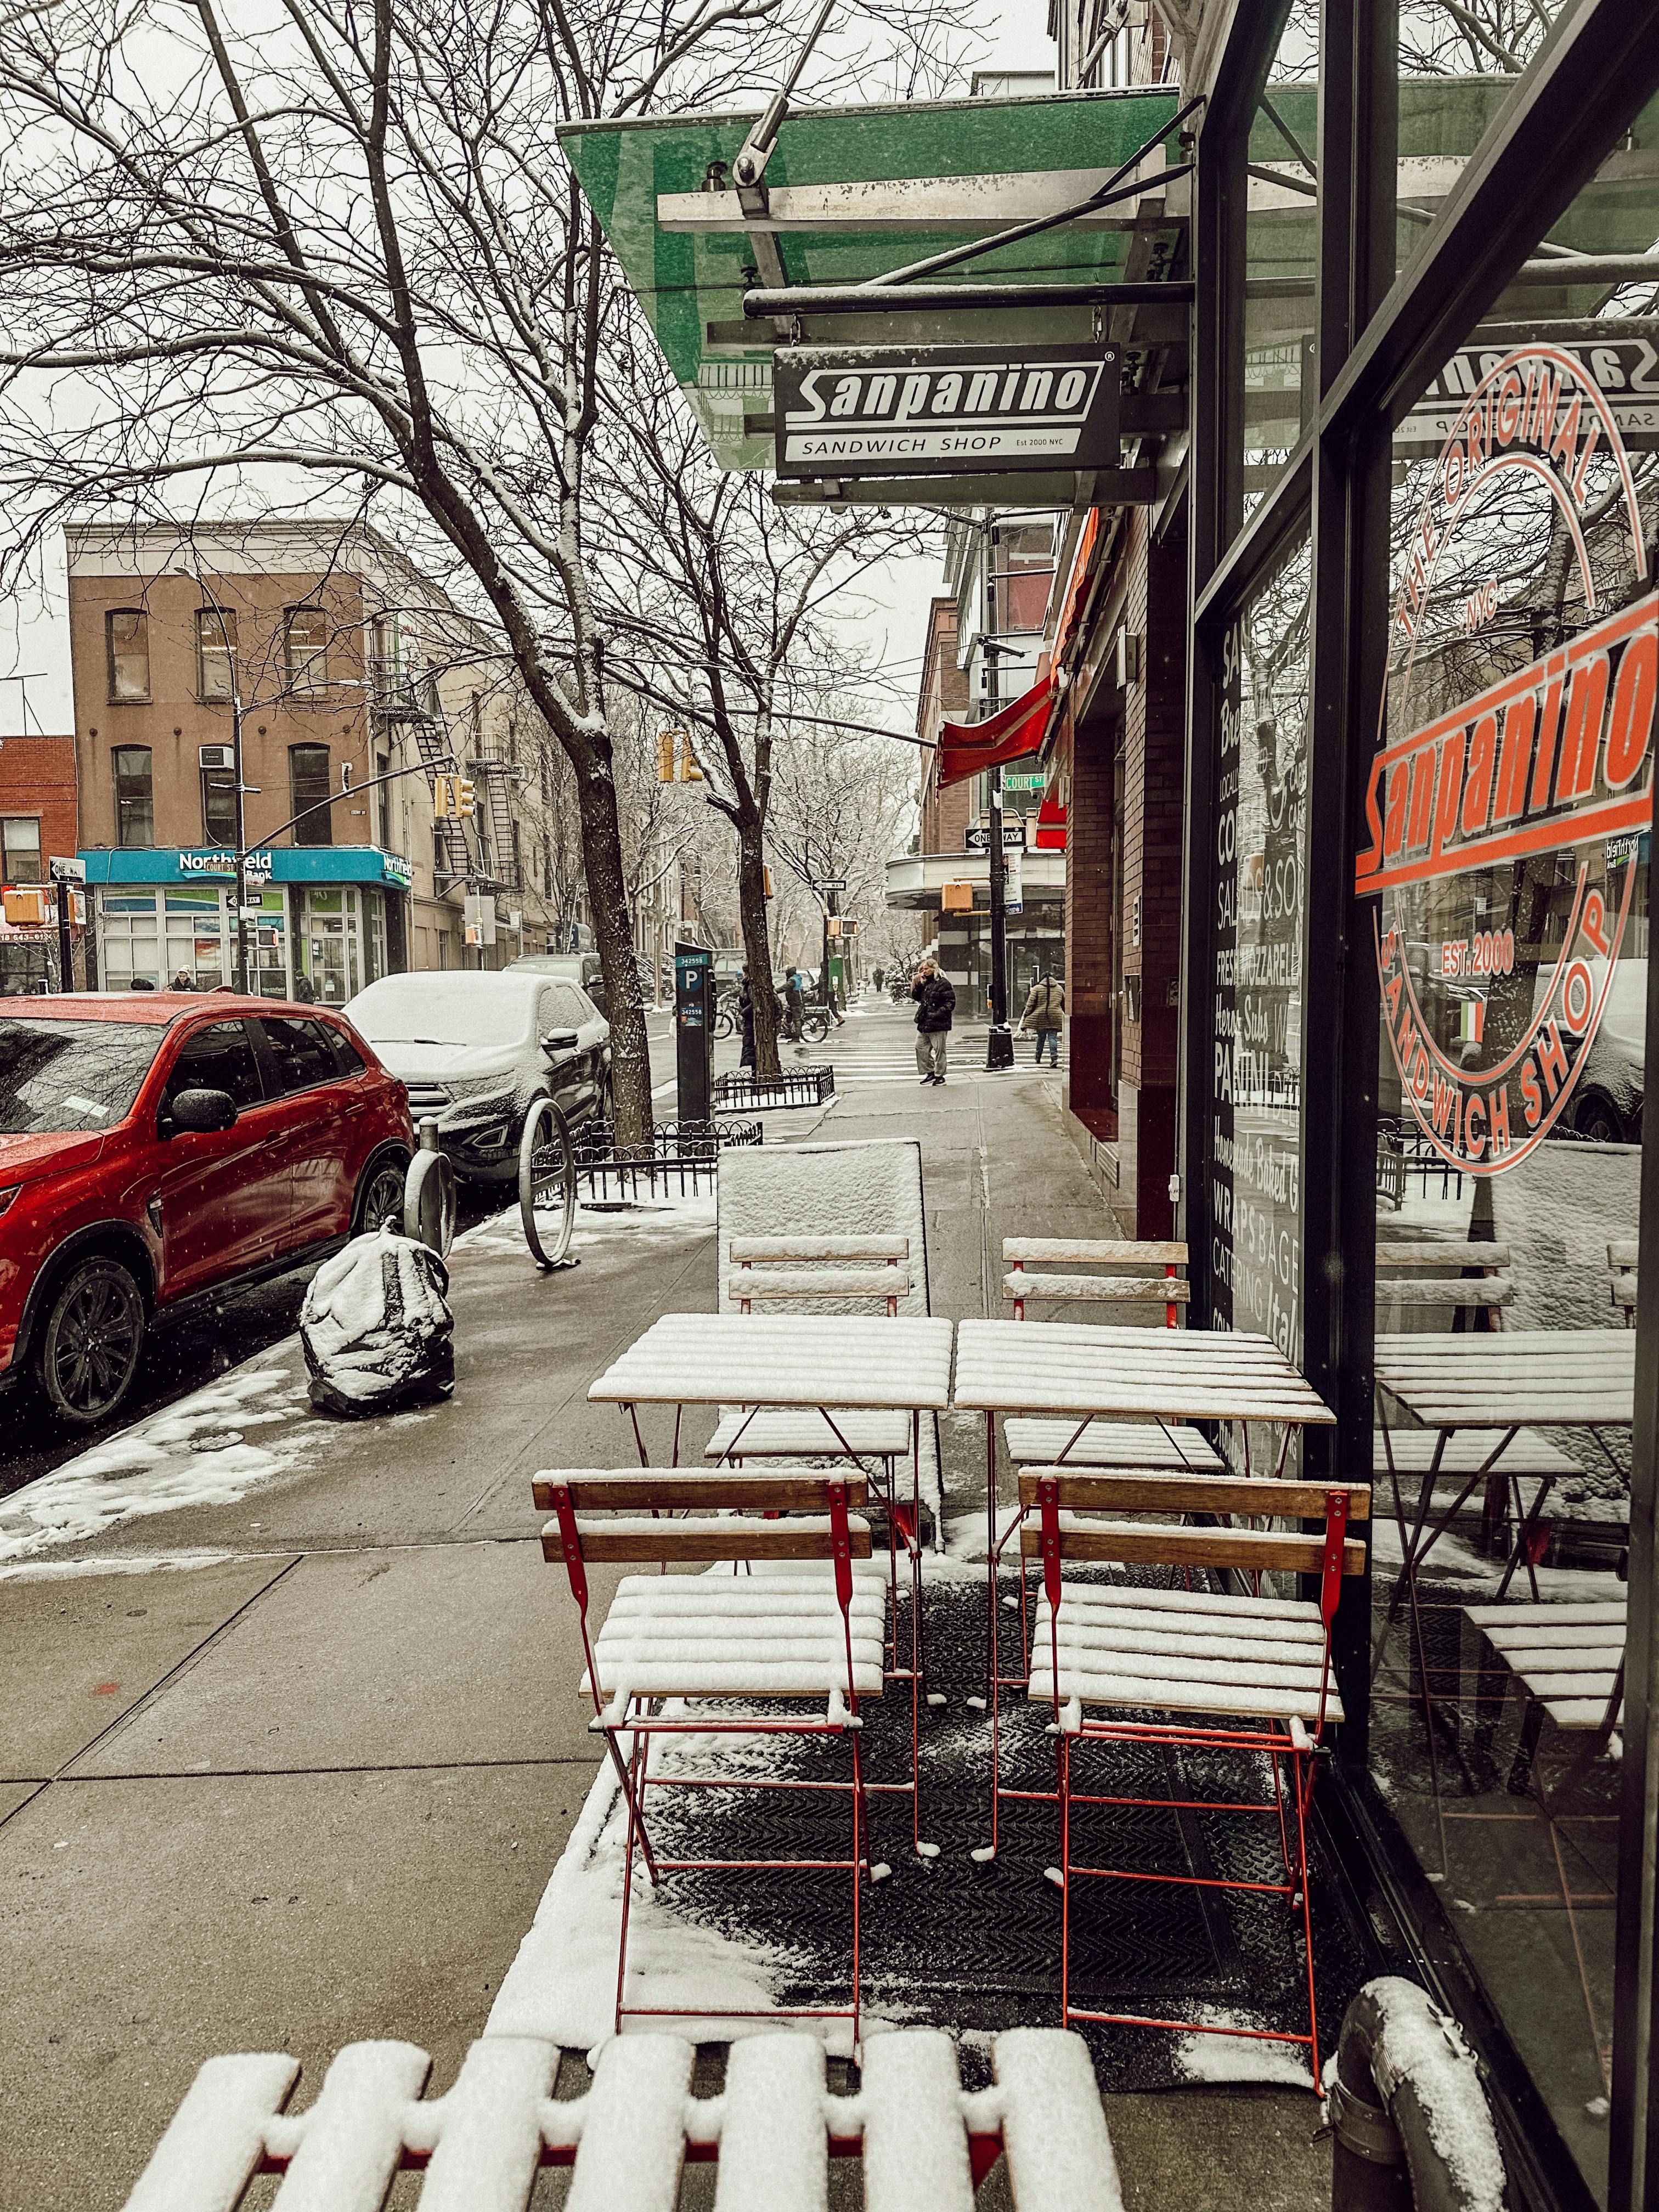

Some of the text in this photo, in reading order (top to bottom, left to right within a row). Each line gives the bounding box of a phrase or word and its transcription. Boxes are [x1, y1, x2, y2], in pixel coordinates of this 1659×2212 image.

[786, 364, 1088, 421] Sanpanino
[802, 439, 926, 454] SANDWICH
[940, 437, 1001, 450] SHOP
[1443, 364, 1601, 509] ORIGINAL
[1355, 625, 1659, 880] Sanpanino
[1006, 777, 1032, 789] COURT
[179, 851, 272, 870] Northeld
[974, 834, 990, 843] ONE
[55, 865, 66, 874] ONE
[206, 863, 224, 872] COURT
[686, 970, 698, 989] P
[1244, 994, 1269, 1045] Subs
[1381, 888, 1611, 1159] SANDWICH SHOP
[1215, 1041, 1269, 1120] PANINI
[1214, 1115, 1254, 1184] Homemade
[1255, 1137, 1286, 1204] Baked
[1214, 1178, 1255, 1254] WRAPS
[1214, 1237, 1262, 1322] CATERING
